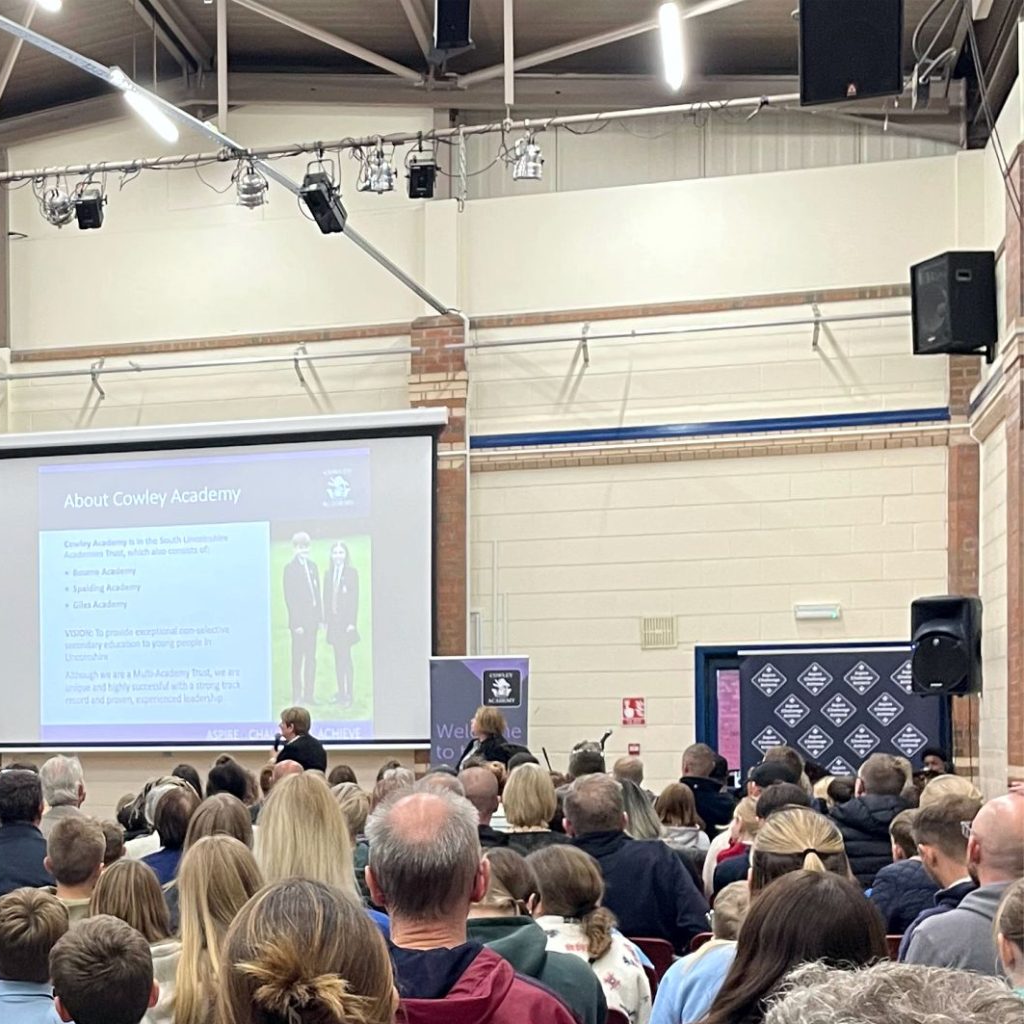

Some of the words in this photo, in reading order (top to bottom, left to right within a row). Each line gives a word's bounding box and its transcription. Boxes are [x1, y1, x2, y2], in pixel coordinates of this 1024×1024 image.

[64, 490, 109, 509] About
[113, 488, 167, 508] Cowley
[170, 486, 241, 504] Academy
[64, 539, 91, 548] Cowley
[93, 539, 127, 548] Academy
[145, 536, 158, 545] the
[160, 535, 181, 544] South
[101, 567, 136, 576] Academy
[106, 583, 141, 592] Academy
[73, 601, 92, 609] Giles
[93, 600, 127, 609] Academy
[206, 729, 239, 740] ASPIRE
[318, 728, 361, 739] ACHIEVE
[437, 745, 455, 759] to
